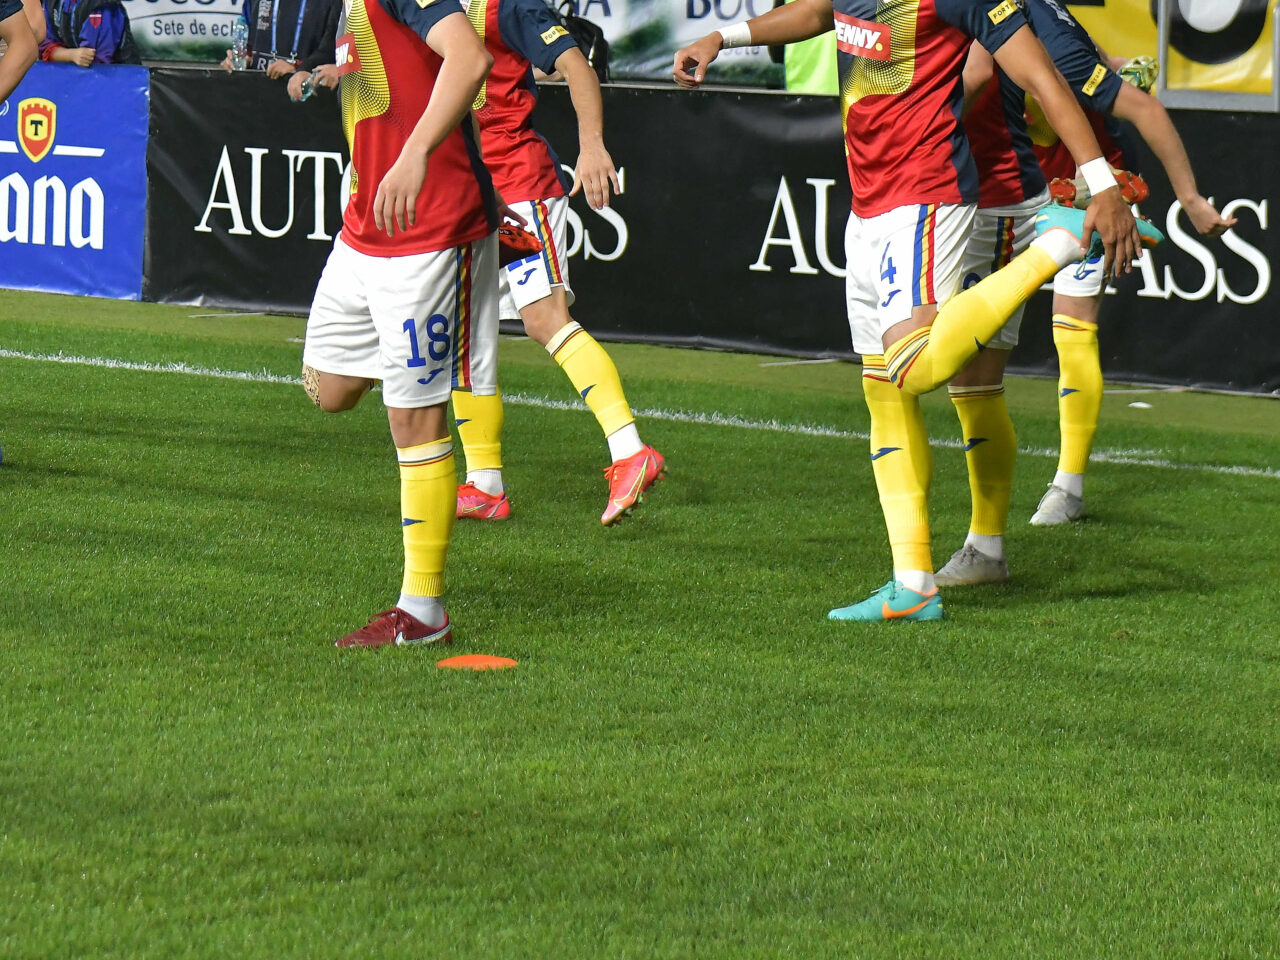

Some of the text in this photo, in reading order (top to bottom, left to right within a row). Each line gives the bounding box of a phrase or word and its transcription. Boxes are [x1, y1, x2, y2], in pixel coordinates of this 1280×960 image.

[153, 19, 184, 36] Sete
[190, 20, 206, 36] de
[30, 120, 43, 136] T
[880, 241, 897, 284] 4
[403, 314, 450, 367] 18
